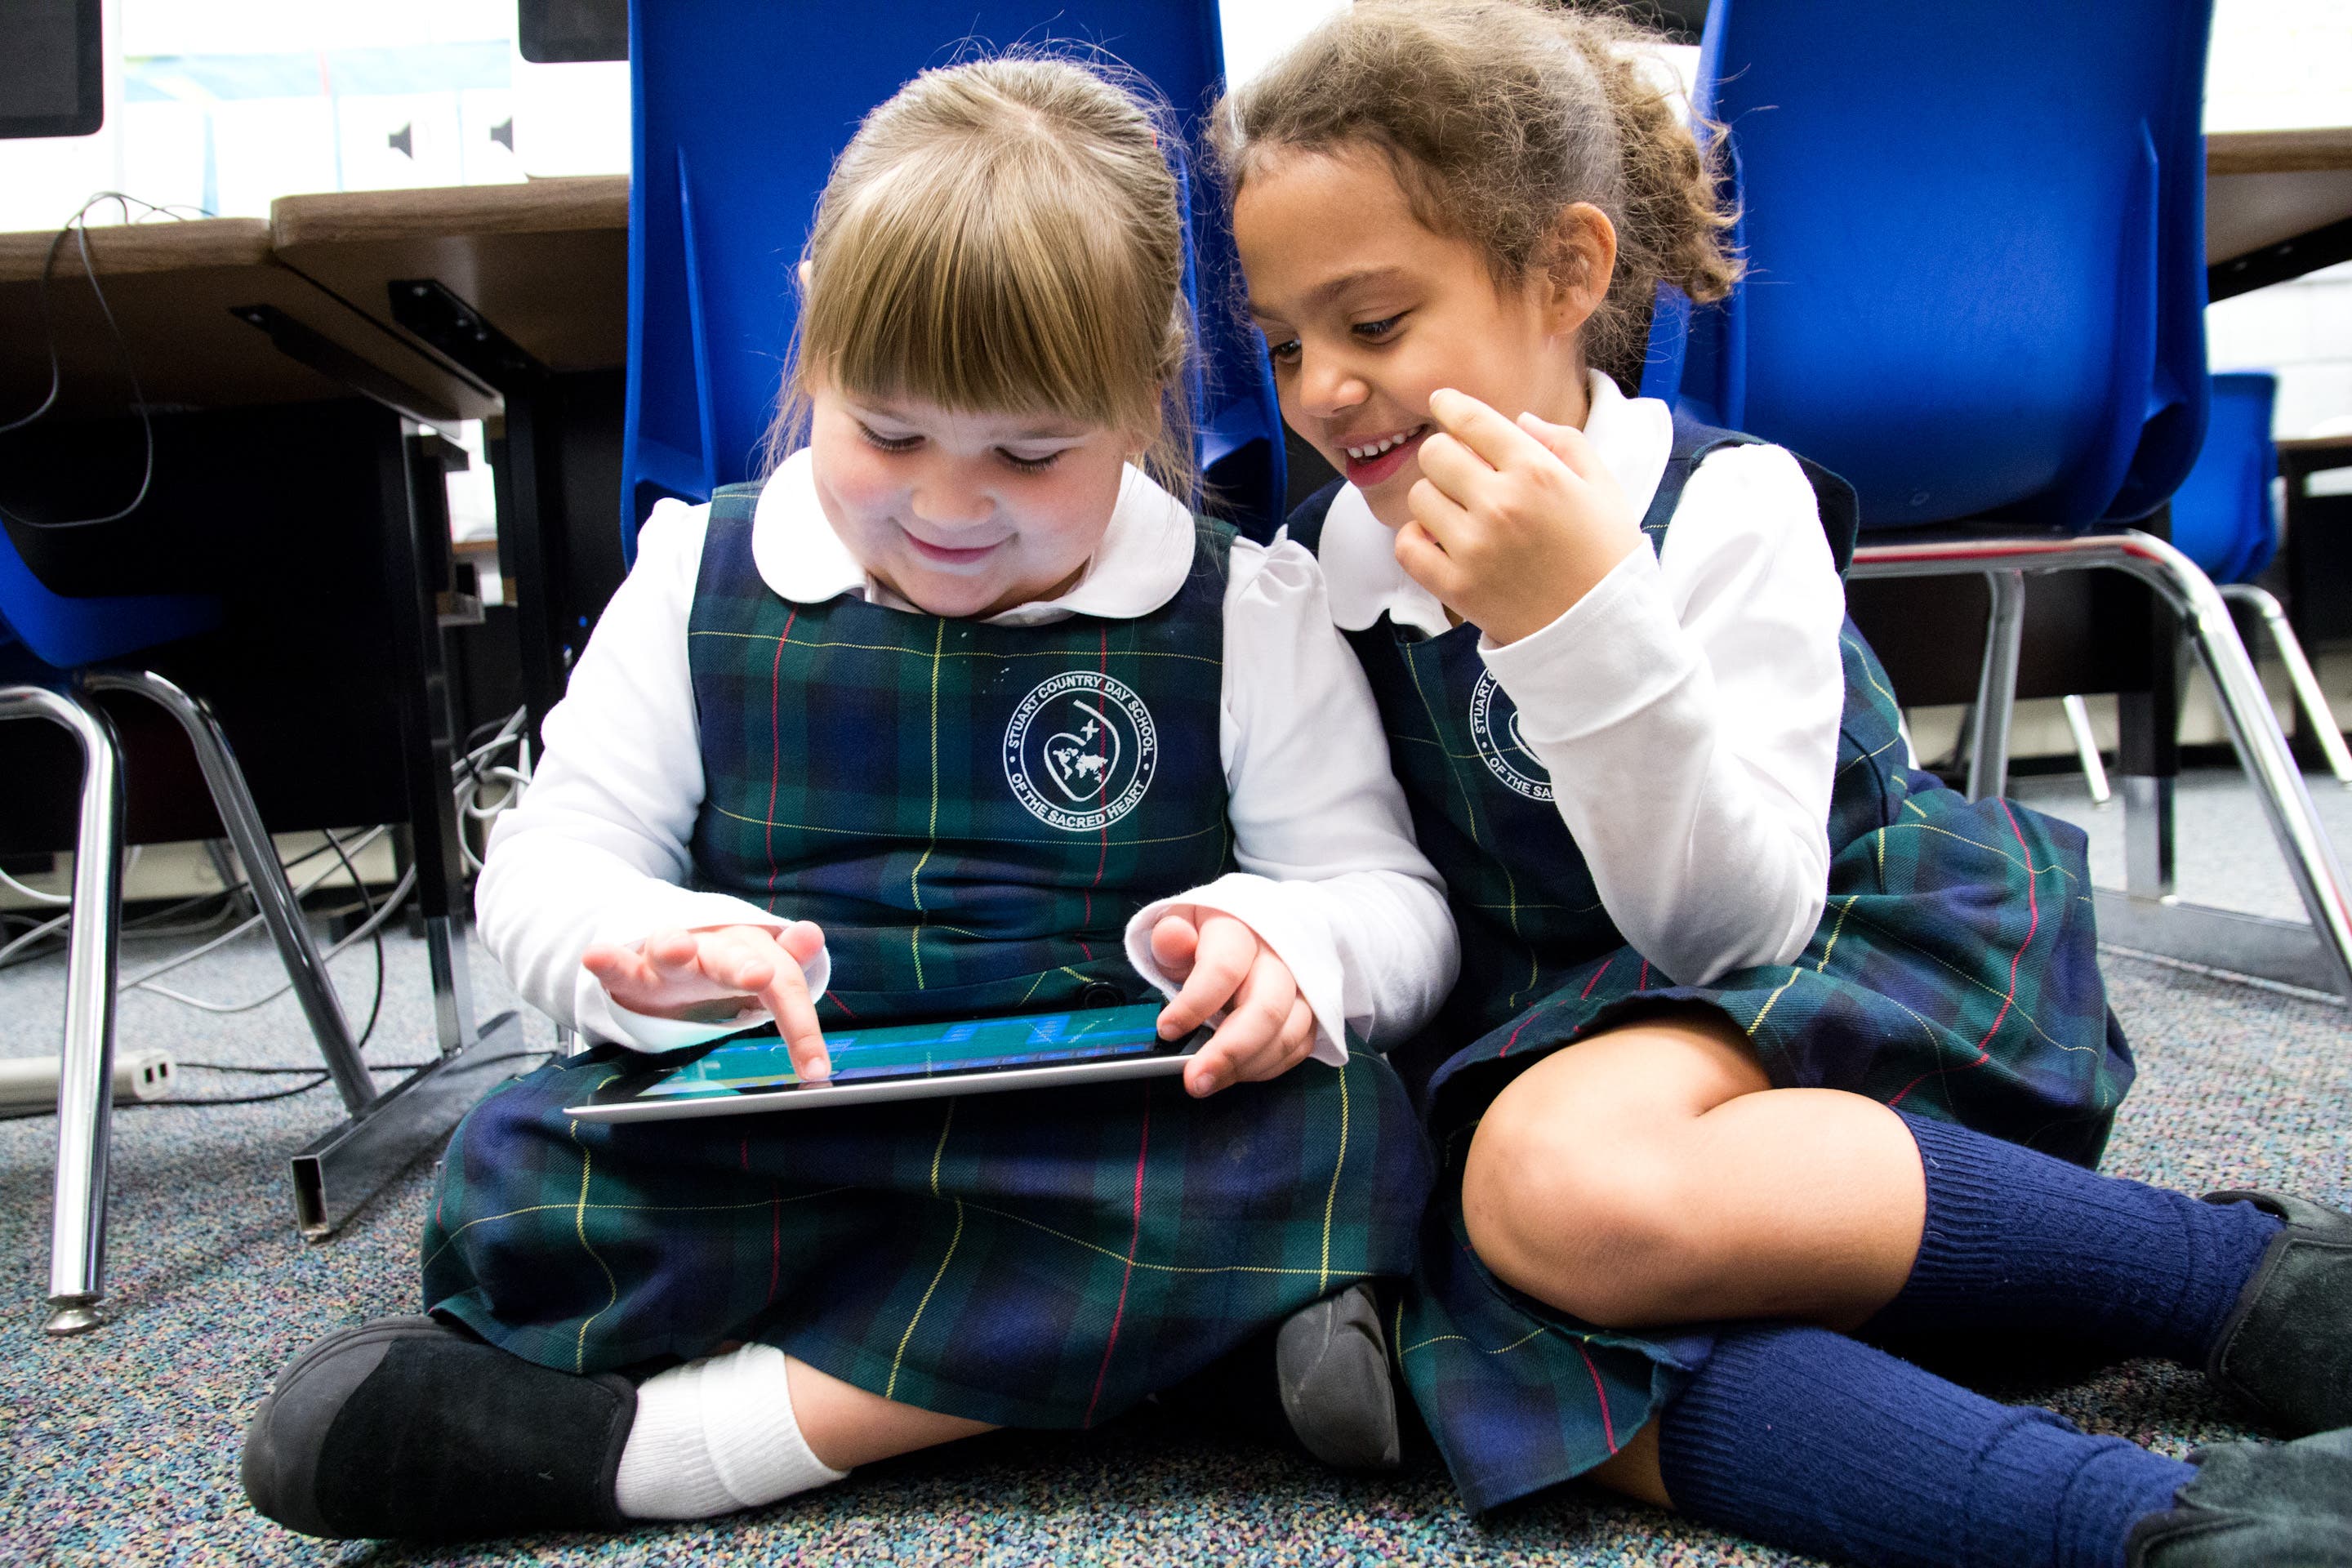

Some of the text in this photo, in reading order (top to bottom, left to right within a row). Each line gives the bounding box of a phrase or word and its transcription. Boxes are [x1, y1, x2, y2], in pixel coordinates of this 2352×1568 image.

[1008, 675, 1154, 756] STUART COUNTRY DAY SCHOOL
[1473, 679, 1491, 734] STUART
[1011, 773, 1145, 828] OF THE SACRED HEART
[1489, 757, 1507, 774] OF
[1506, 772, 1532, 794] THE
